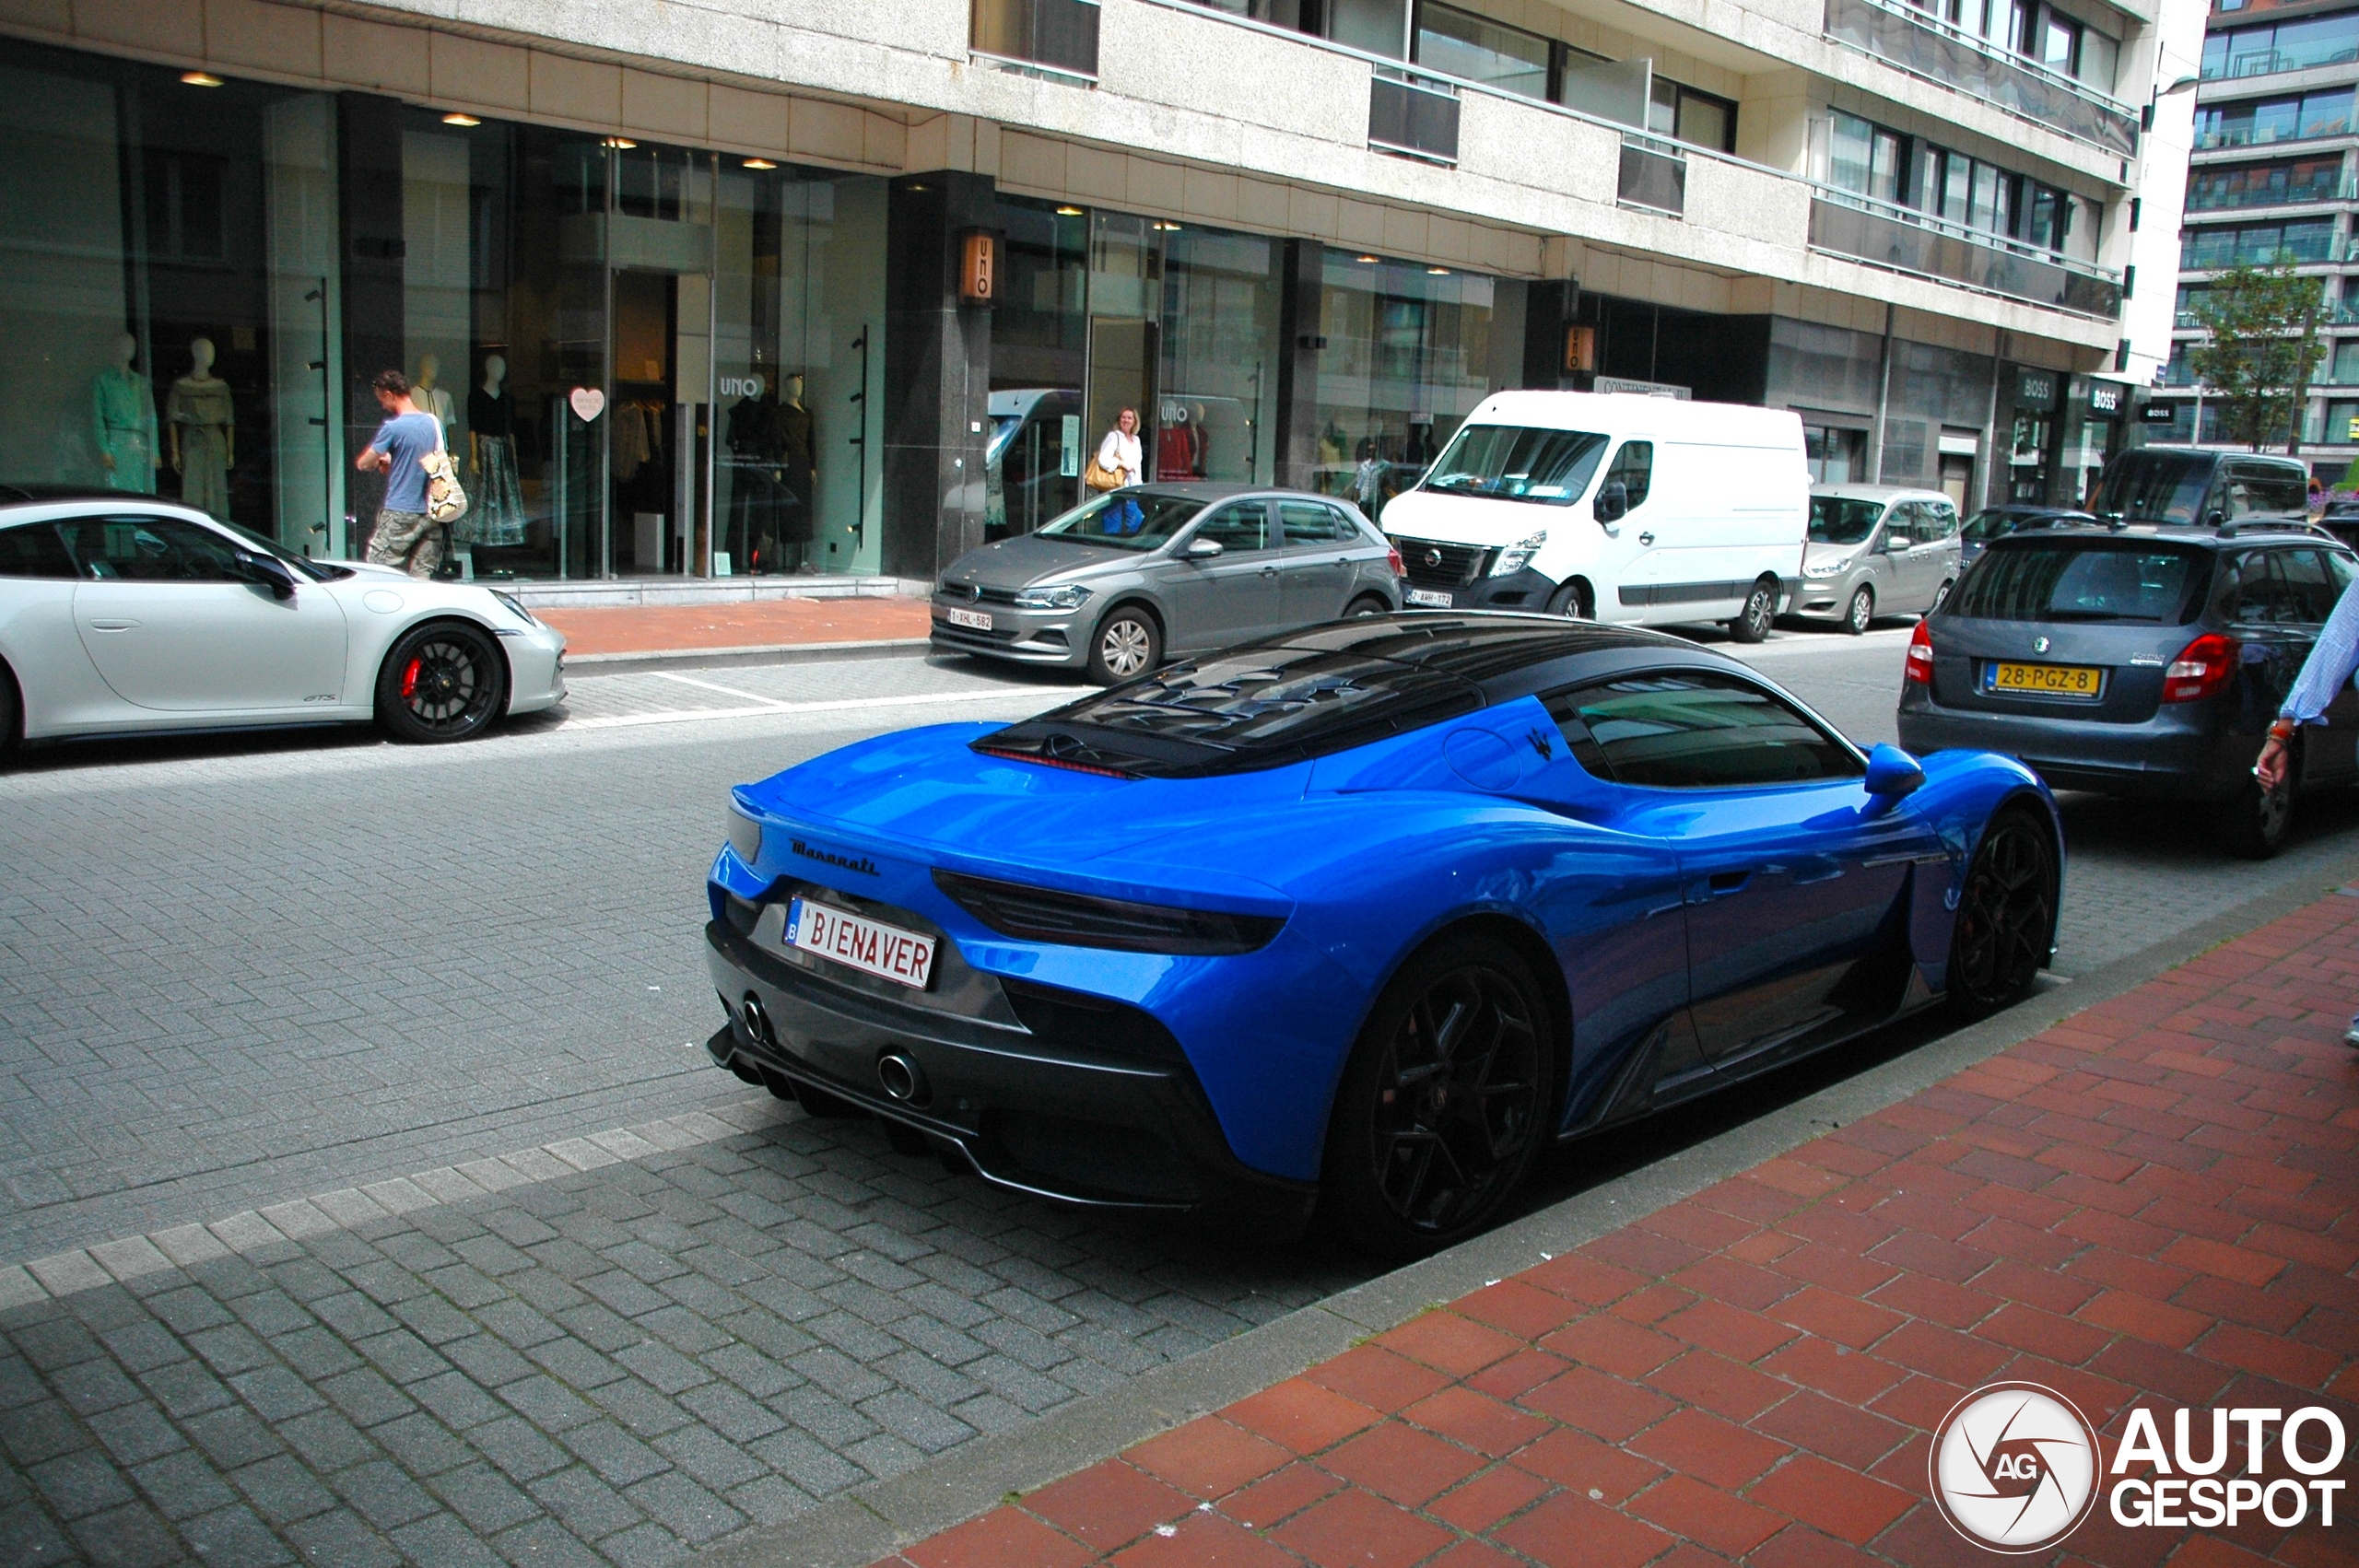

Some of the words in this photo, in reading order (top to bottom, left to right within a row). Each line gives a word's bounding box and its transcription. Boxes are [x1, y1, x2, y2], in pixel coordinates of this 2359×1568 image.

[977, 240, 989, 295] UNO
[721, 378, 757, 396] UNO
[2025, 379, 2049, 400] BOSS
[2093, 390, 2117, 411] BOSS
[1161, 406, 1188, 422] UNO
[2147, 408, 2169, 417] BOSS
[2001, 667, 2089, 689] 28-PGZ-8
[788, 924, 797, 940] B
[811, 911, 929, 980] BIENAVER
